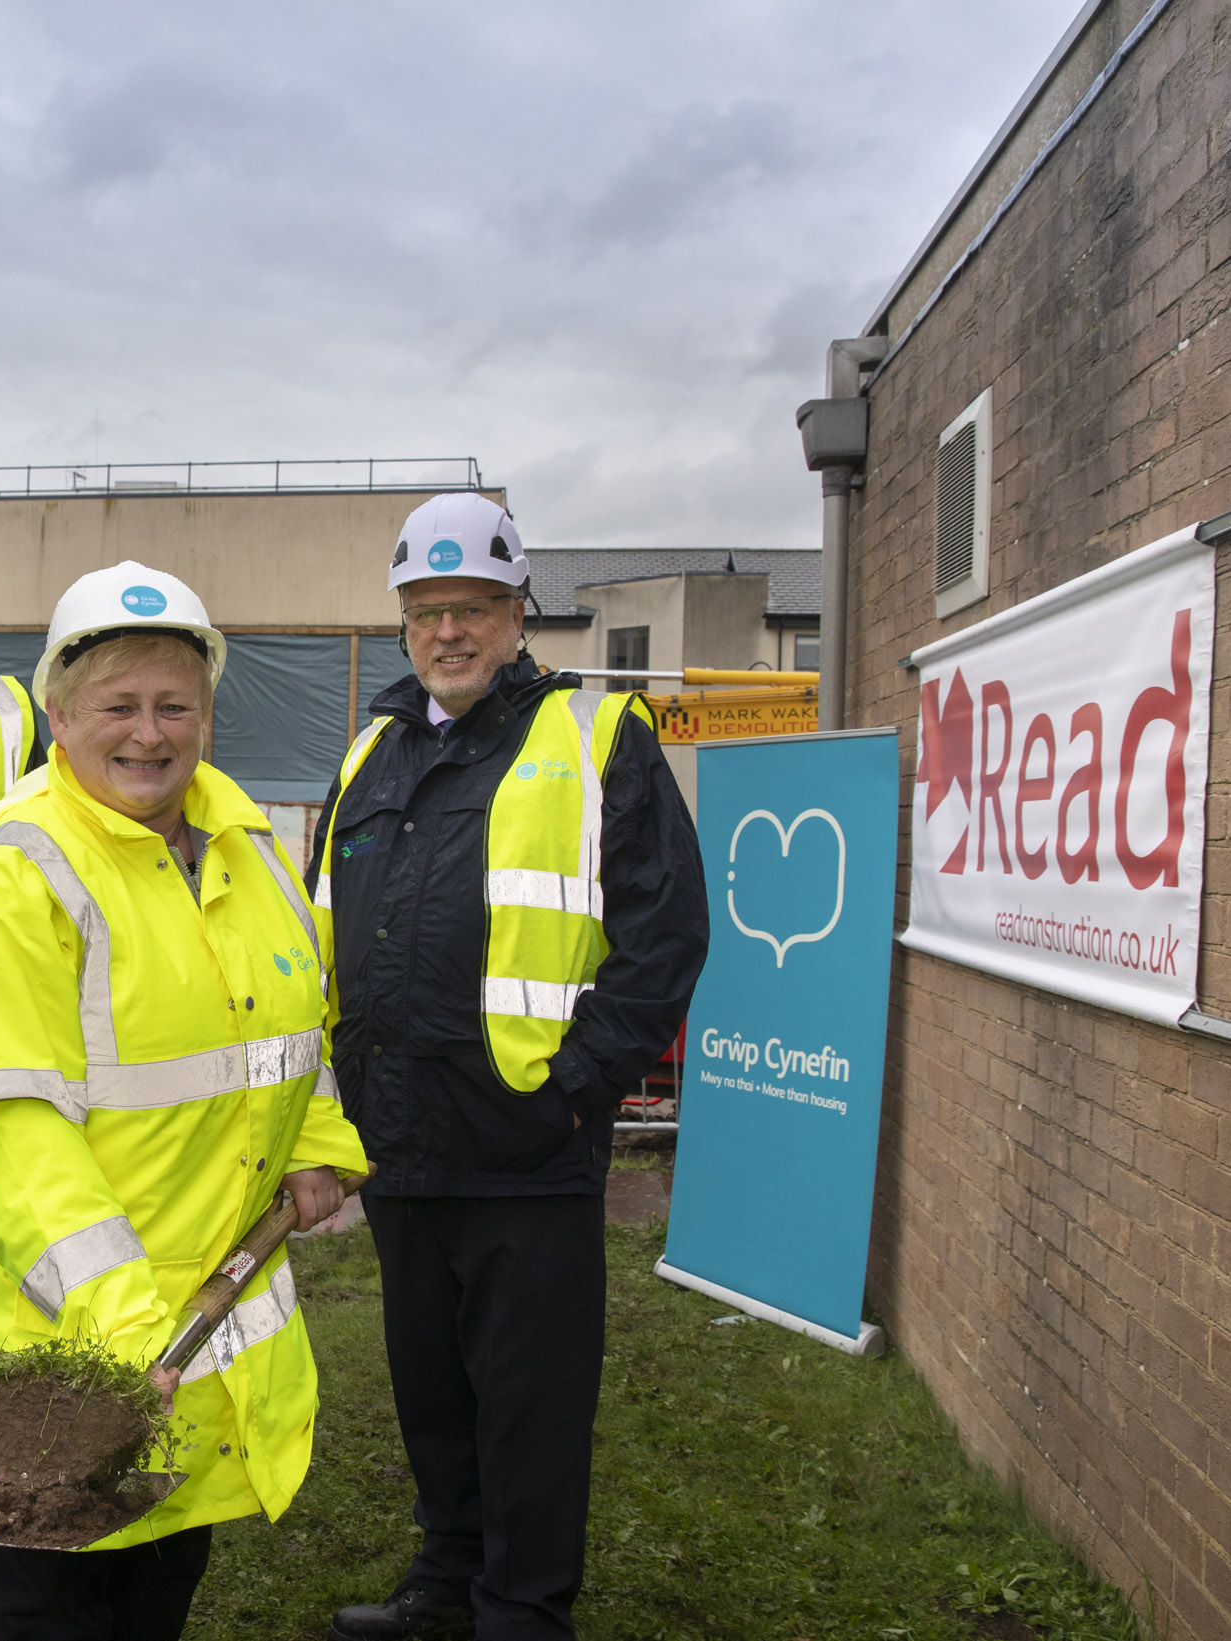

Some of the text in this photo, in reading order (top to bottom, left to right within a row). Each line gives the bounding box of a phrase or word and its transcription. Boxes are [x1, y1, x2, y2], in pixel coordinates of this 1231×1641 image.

[708, 708, 762, 720] MARK
[543, 768, 578, 780] Cynefin
[976, 608, 1192, 891] Read
[994, 903, 1180, 976] readconstruction.co.uk
[701, 1027, 850, 1083] Grŵp Cynefin
[700, 1069, 847, 1116] Mwy na thai More than housing
